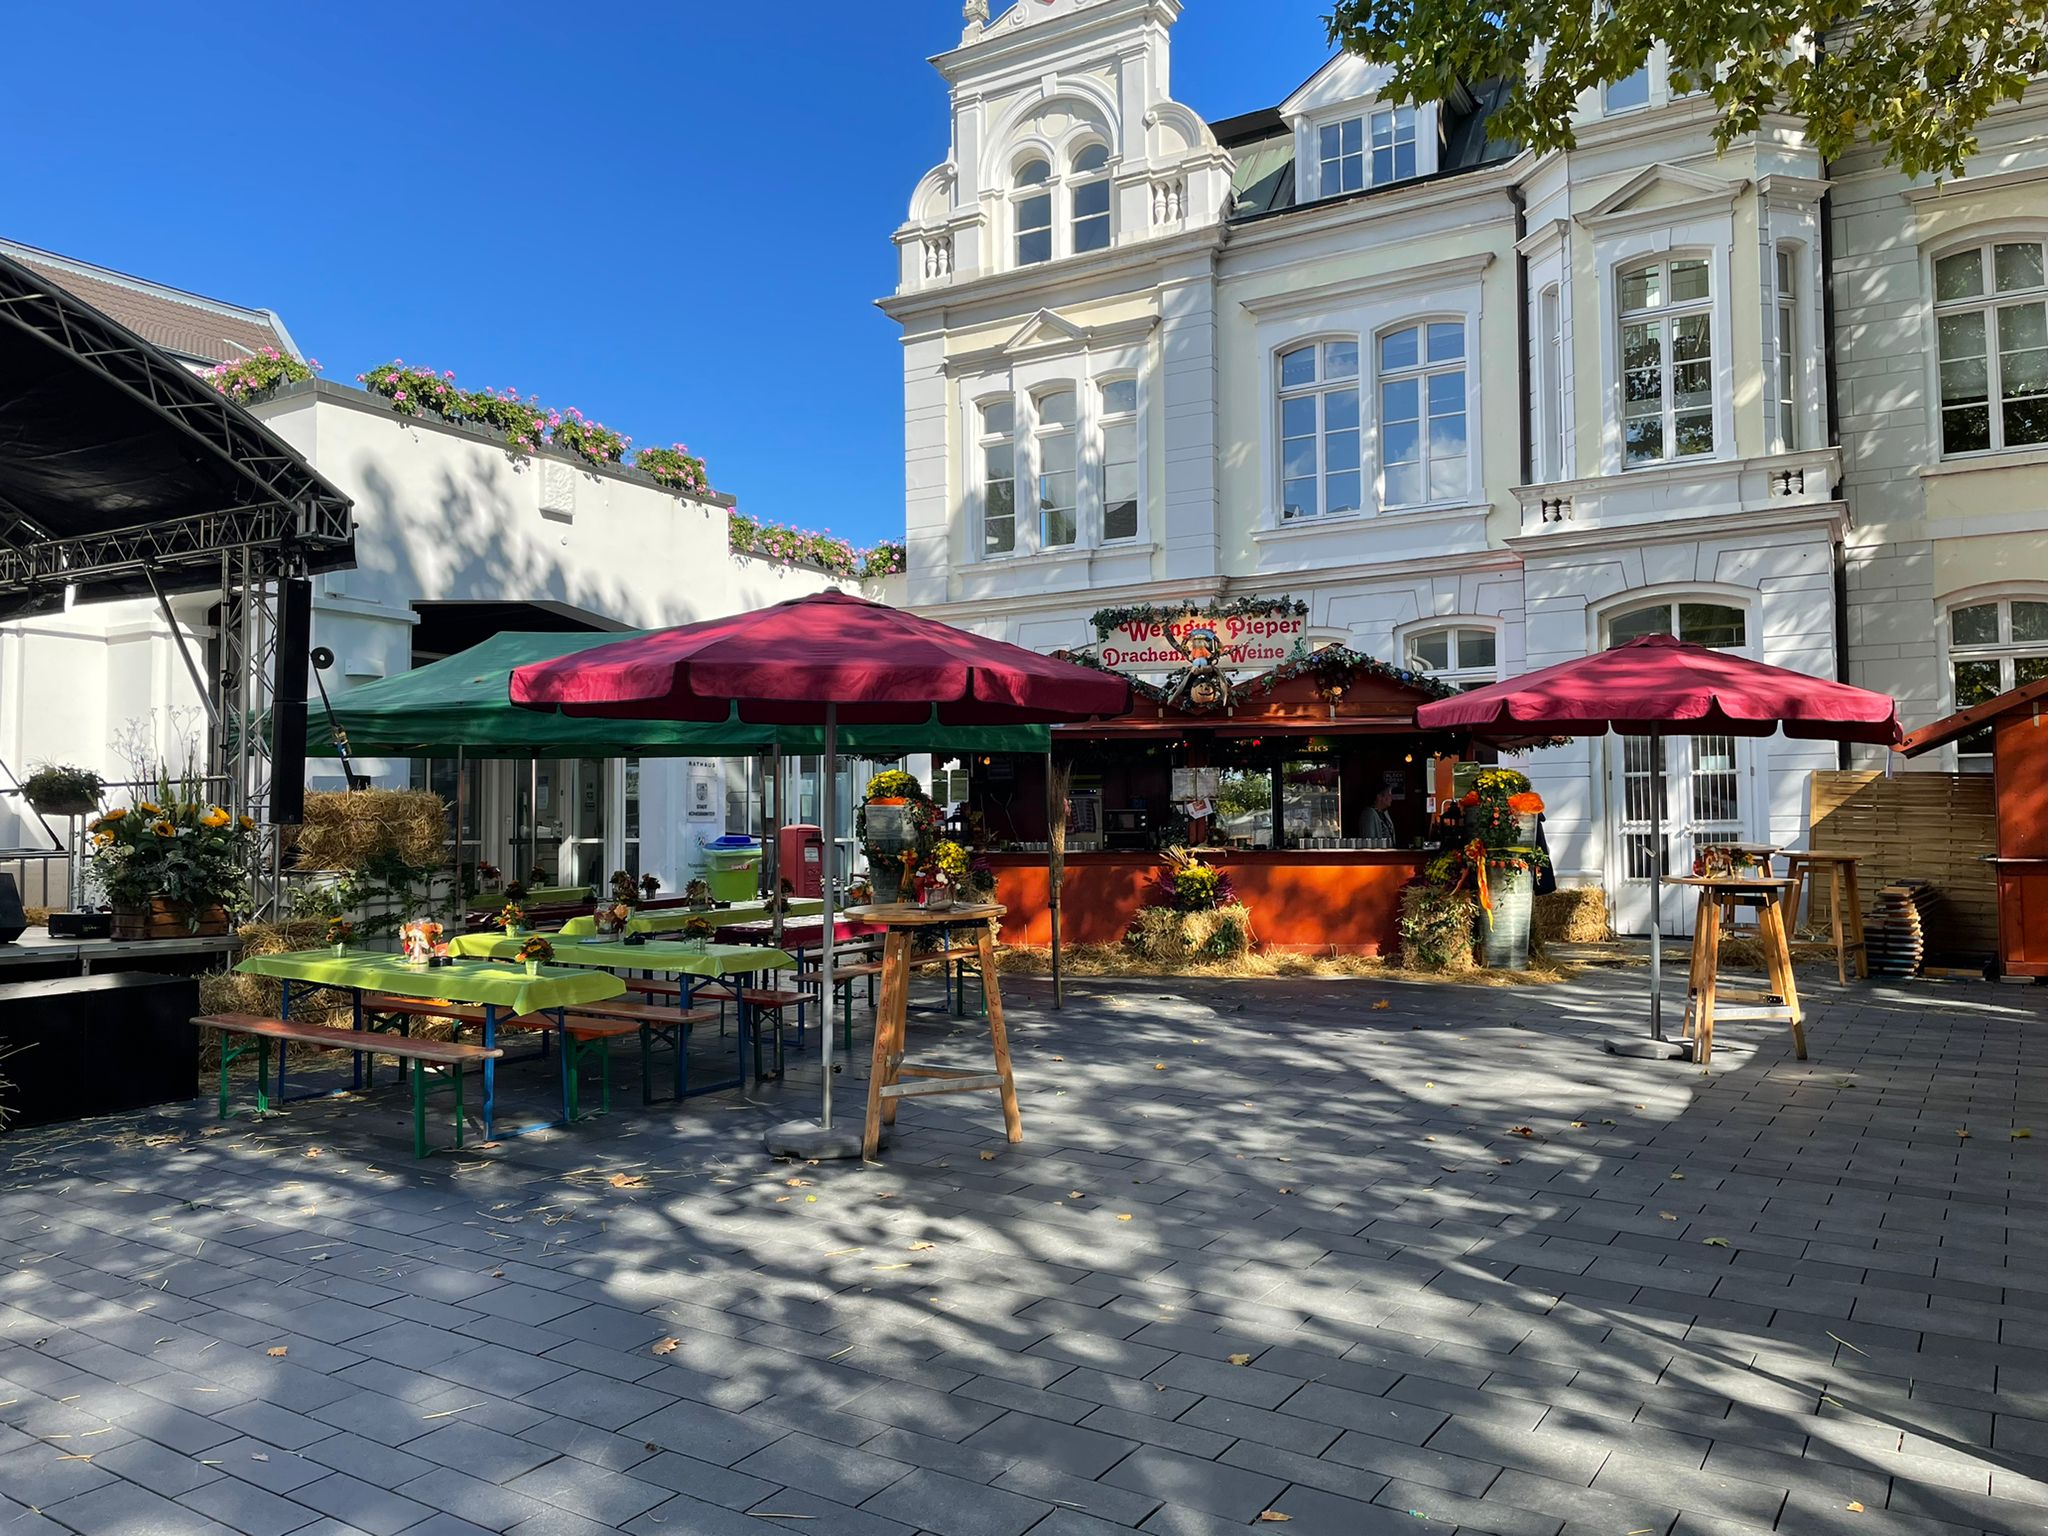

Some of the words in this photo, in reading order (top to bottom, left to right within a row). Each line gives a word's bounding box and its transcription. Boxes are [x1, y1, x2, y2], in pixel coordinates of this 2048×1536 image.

[1119, 618, 1217, 642] Wengt
[1225, 615, 1301, 639] Pieper
[1103, 646, 1187, 667] Drachen
[1221, 643, 1285, 664] Weine
